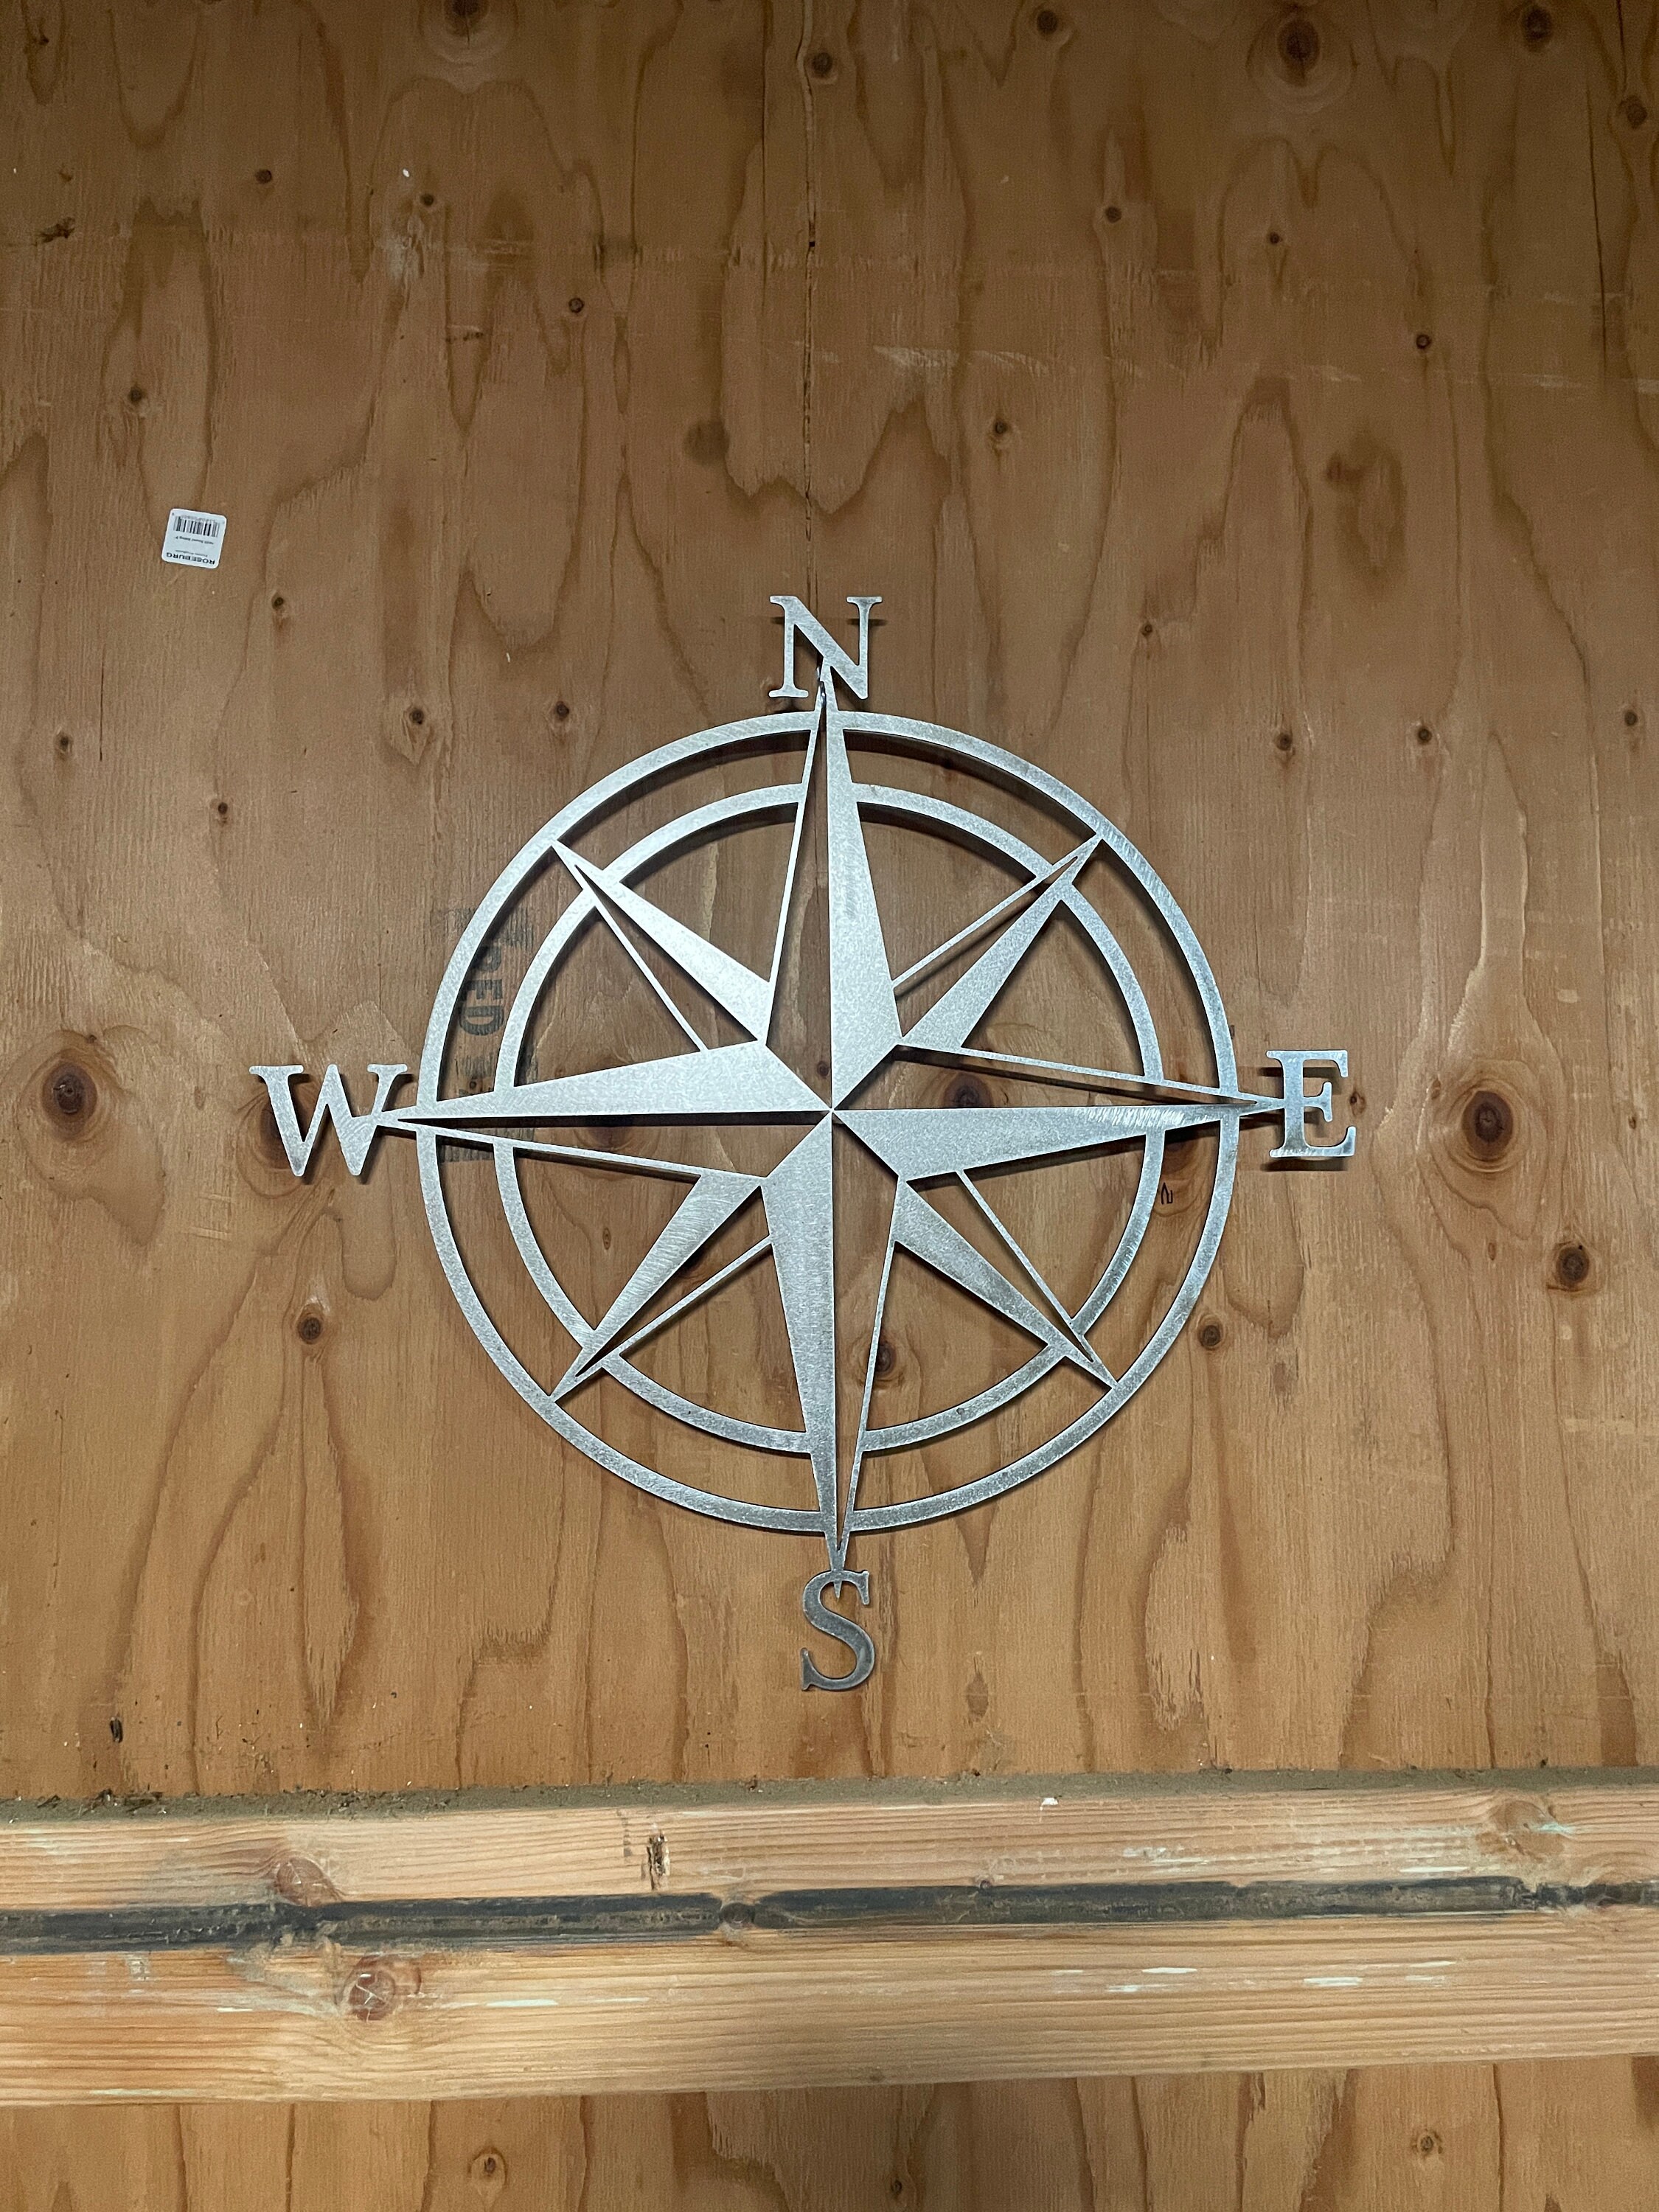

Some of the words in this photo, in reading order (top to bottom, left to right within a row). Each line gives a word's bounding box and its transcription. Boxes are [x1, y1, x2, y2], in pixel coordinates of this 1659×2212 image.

[166, 552, 215, 565] ROSEBURG
[769, 596, 883, 700] N
[249, 1064, 408, 1177] W
[1266, 1050, 1357, 1158] E
[800, 1570, 875, 1691] S
